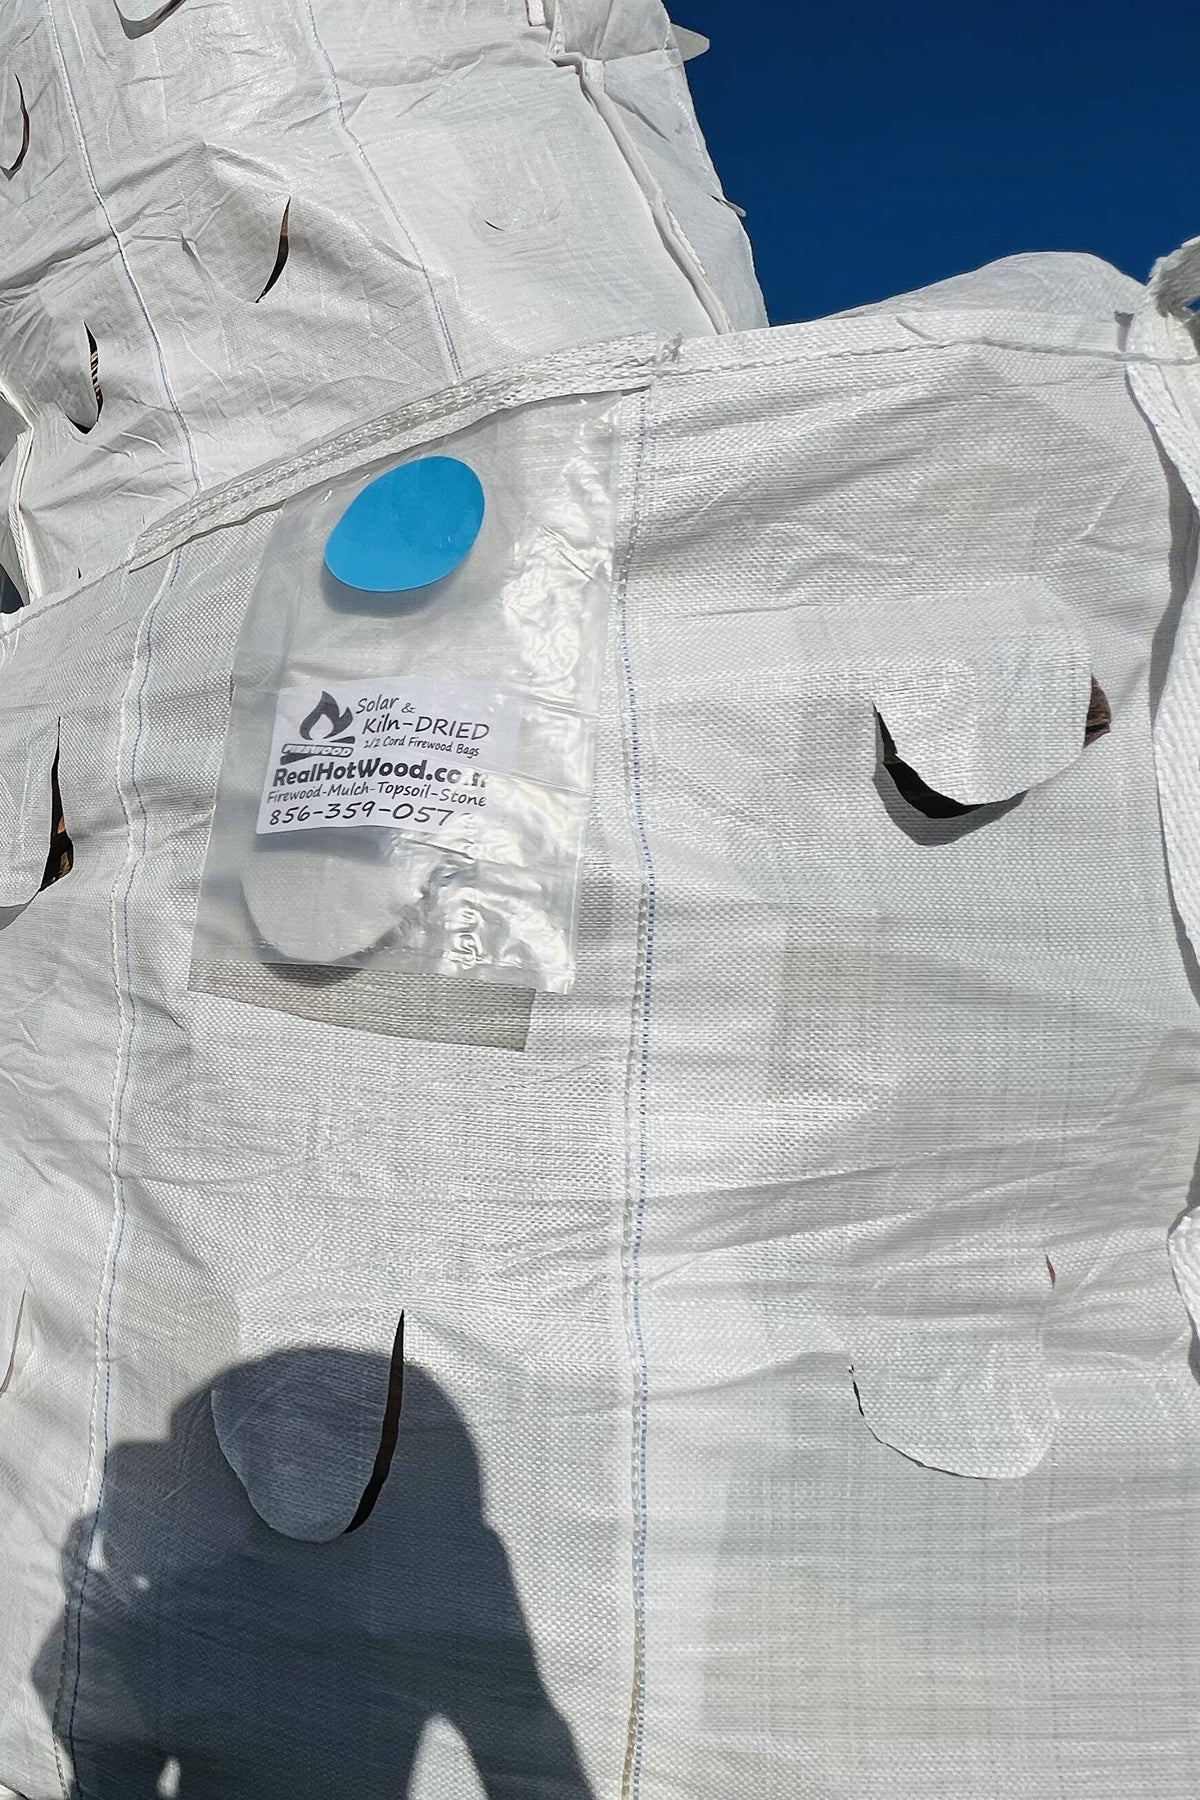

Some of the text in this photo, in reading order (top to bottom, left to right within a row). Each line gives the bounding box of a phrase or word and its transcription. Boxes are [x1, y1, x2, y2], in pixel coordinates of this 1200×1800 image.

[355, 693, 416, 714] Solar &
[361, 713, 490, 740] Kiln-DRIED
[363, 735, 480, 759] 1/2 Cord Firewood Bags
[267, 781, 487, 807] Firewood-Mulch-Topsoil-Stone
[269, 801, 474, 829] 856-359-057
